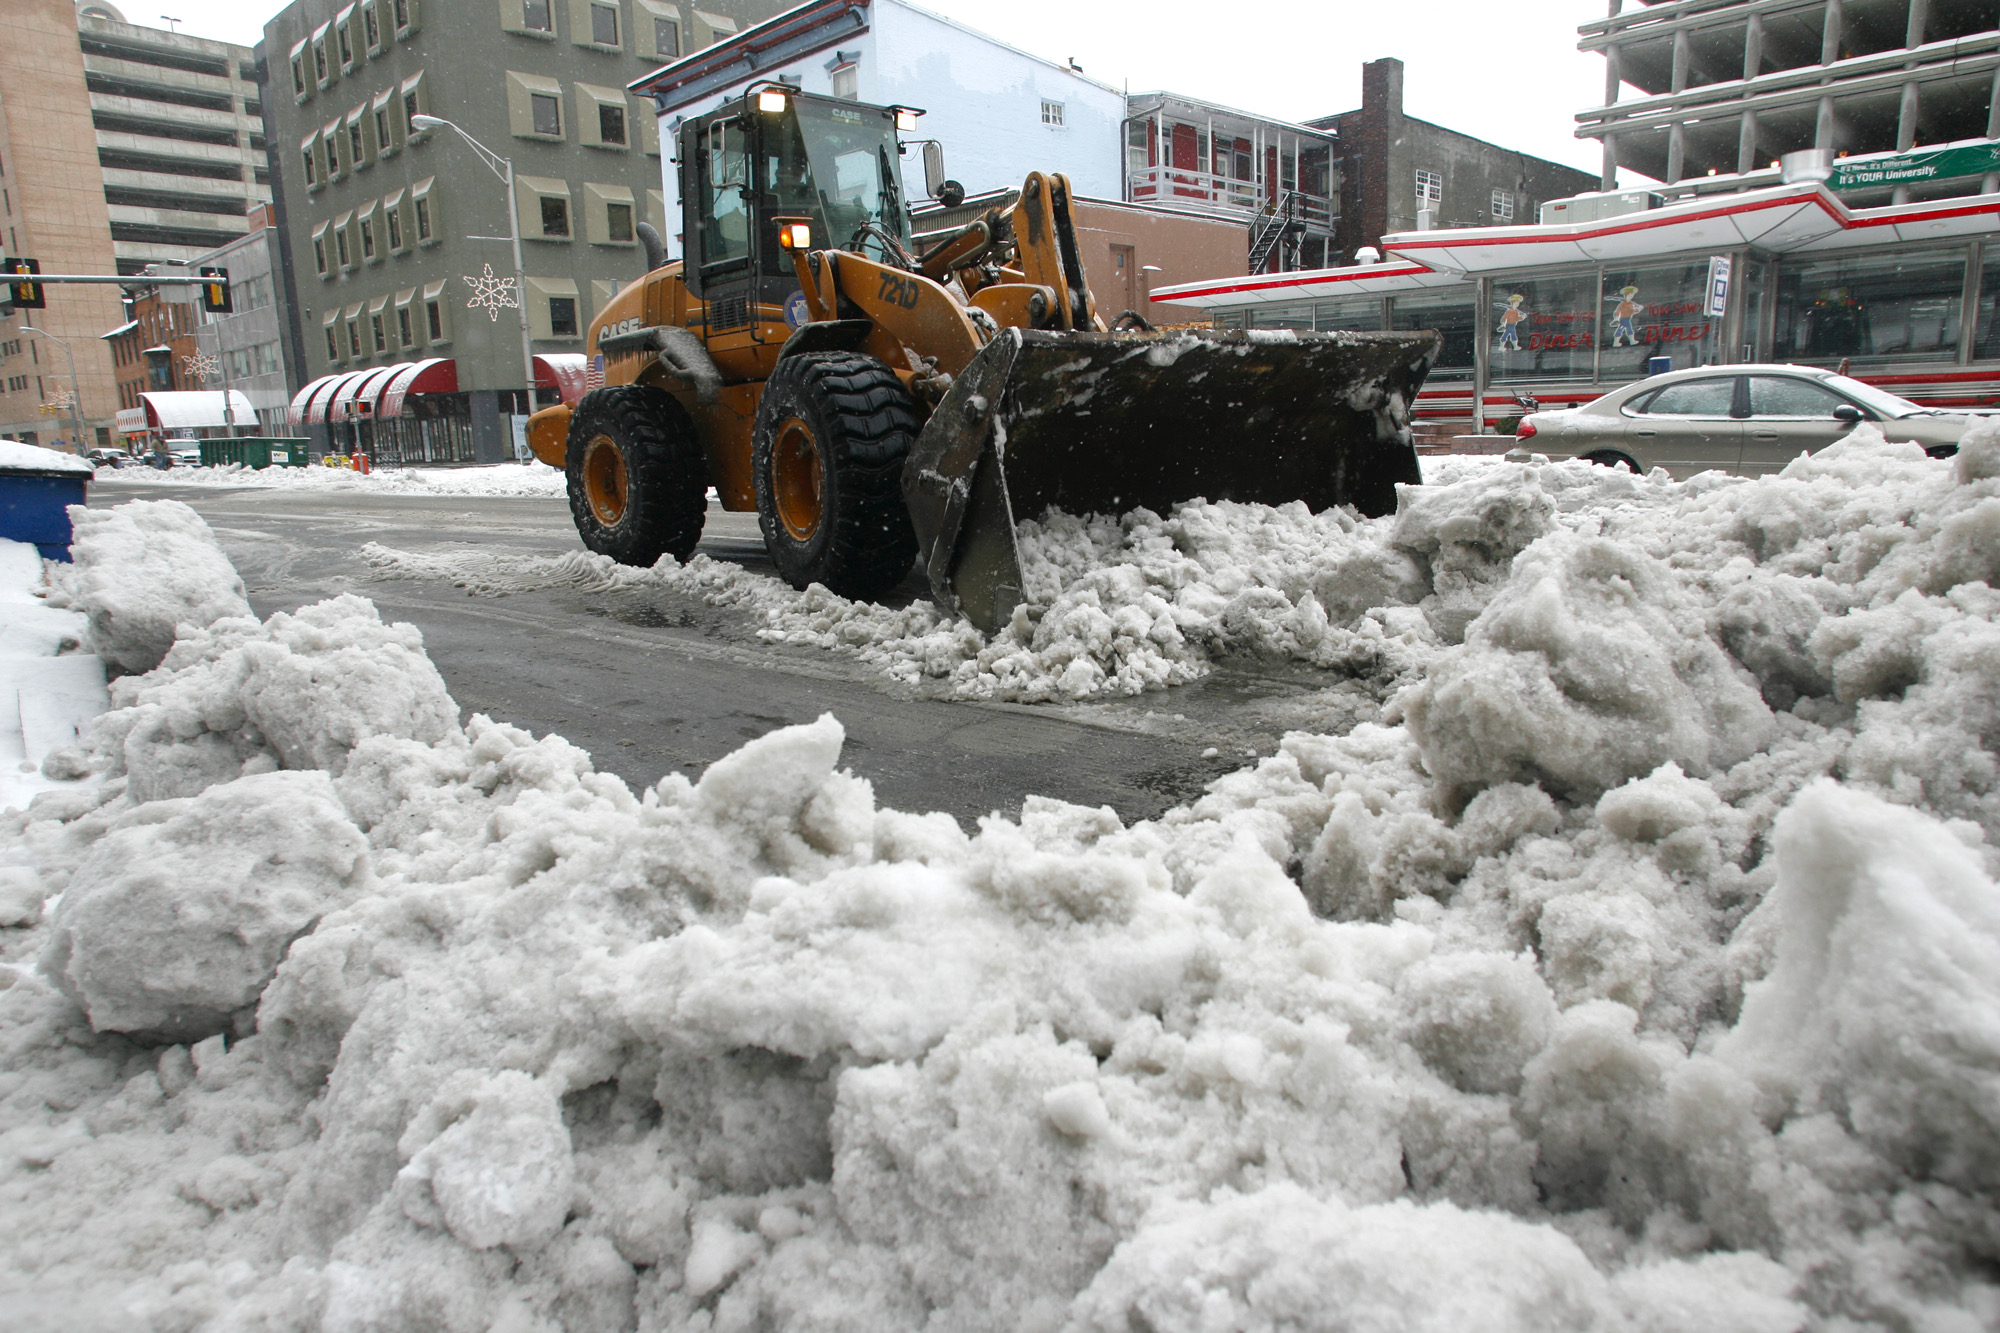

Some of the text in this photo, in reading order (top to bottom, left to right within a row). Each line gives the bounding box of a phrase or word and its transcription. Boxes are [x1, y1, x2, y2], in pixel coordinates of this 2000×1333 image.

[831, 108, 861, 120] CASE
[1839, 166, 1937, 185] It's YOUR University.
[878, 271, 919, 310] 721D
[1532, 310, 1596, 325] TOM SAWYER
[1647, 302, 1671, 317] TOM
[1528, 329, 1595, 350] Diner
